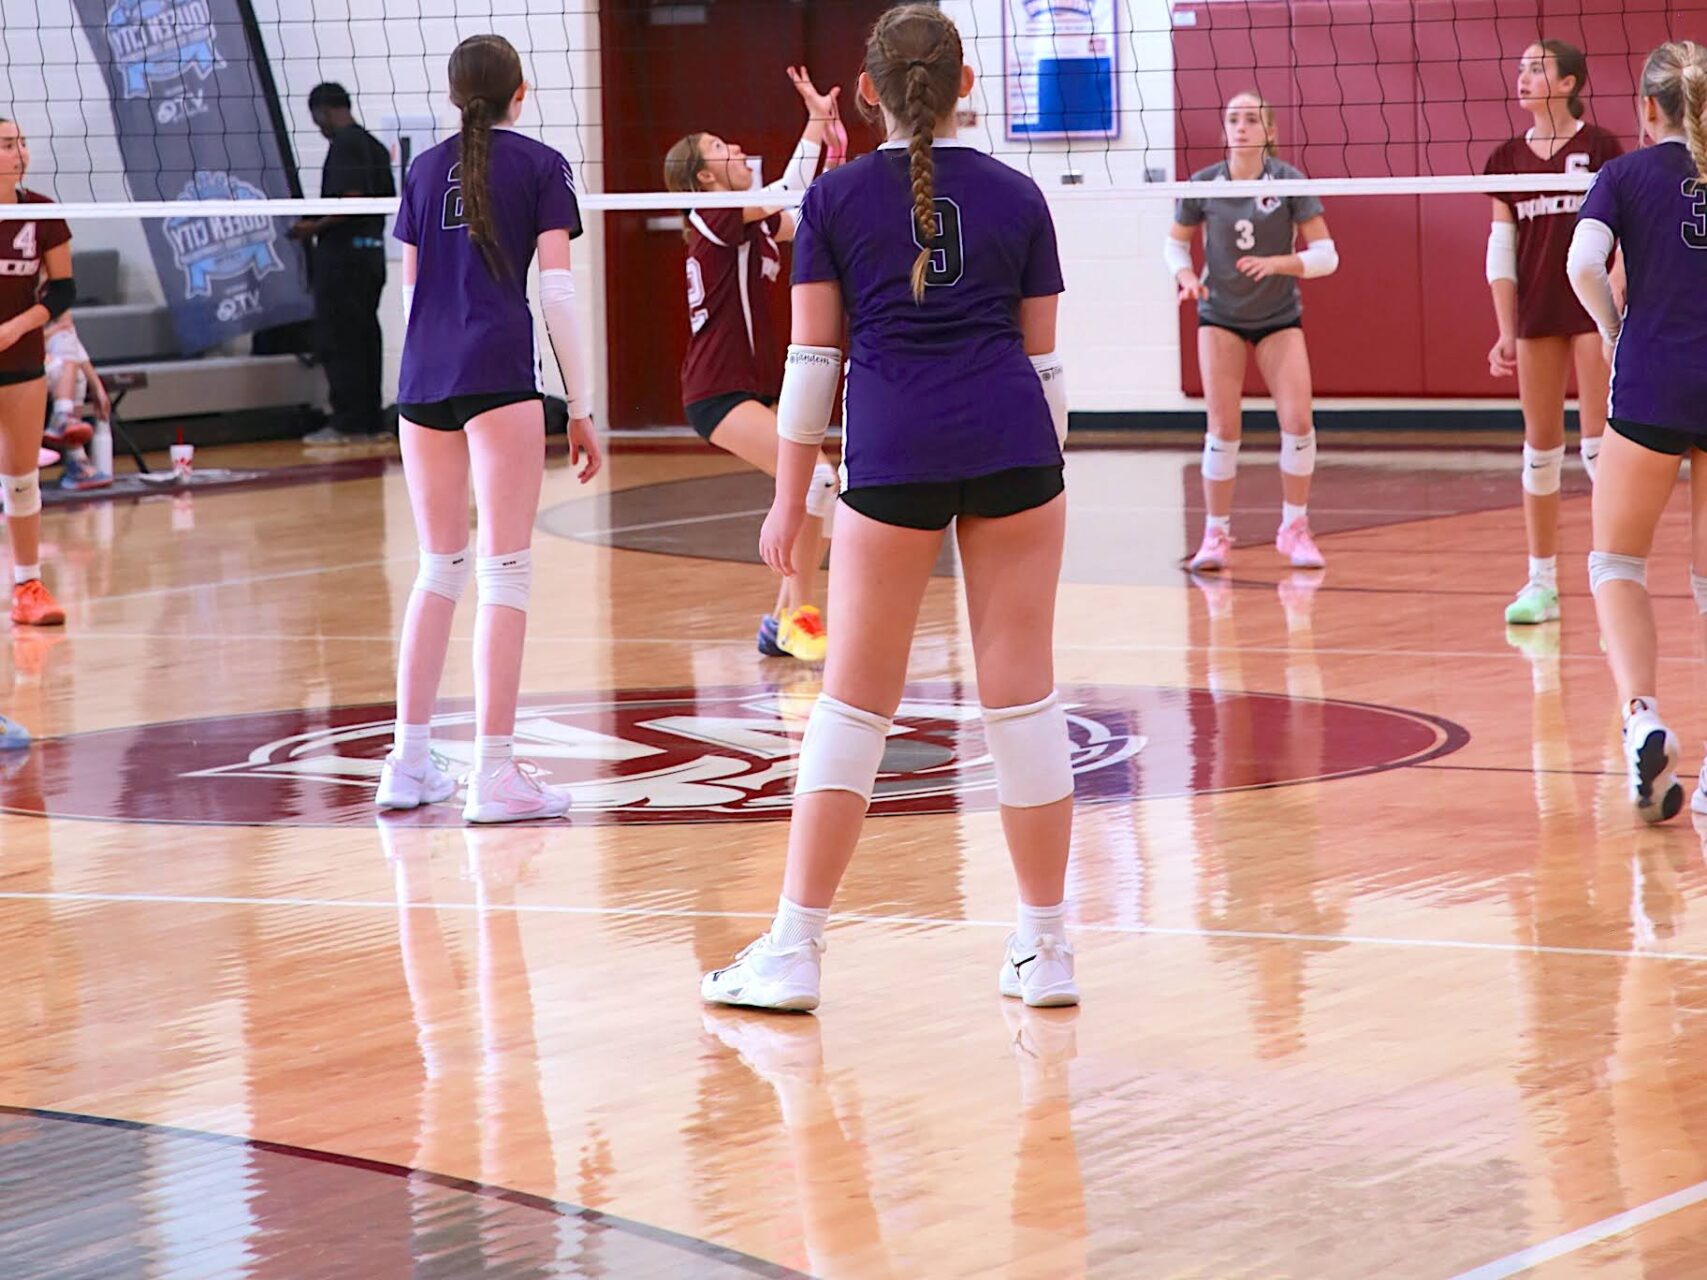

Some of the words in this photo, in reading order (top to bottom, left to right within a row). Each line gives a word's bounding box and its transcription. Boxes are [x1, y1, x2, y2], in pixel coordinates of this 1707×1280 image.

[13, 221, 37, 259] 4
[1234, 219, 1255, 251] 3
[1681, 177, 1707, 250] 3
[911, 197, 964, 287] 9
